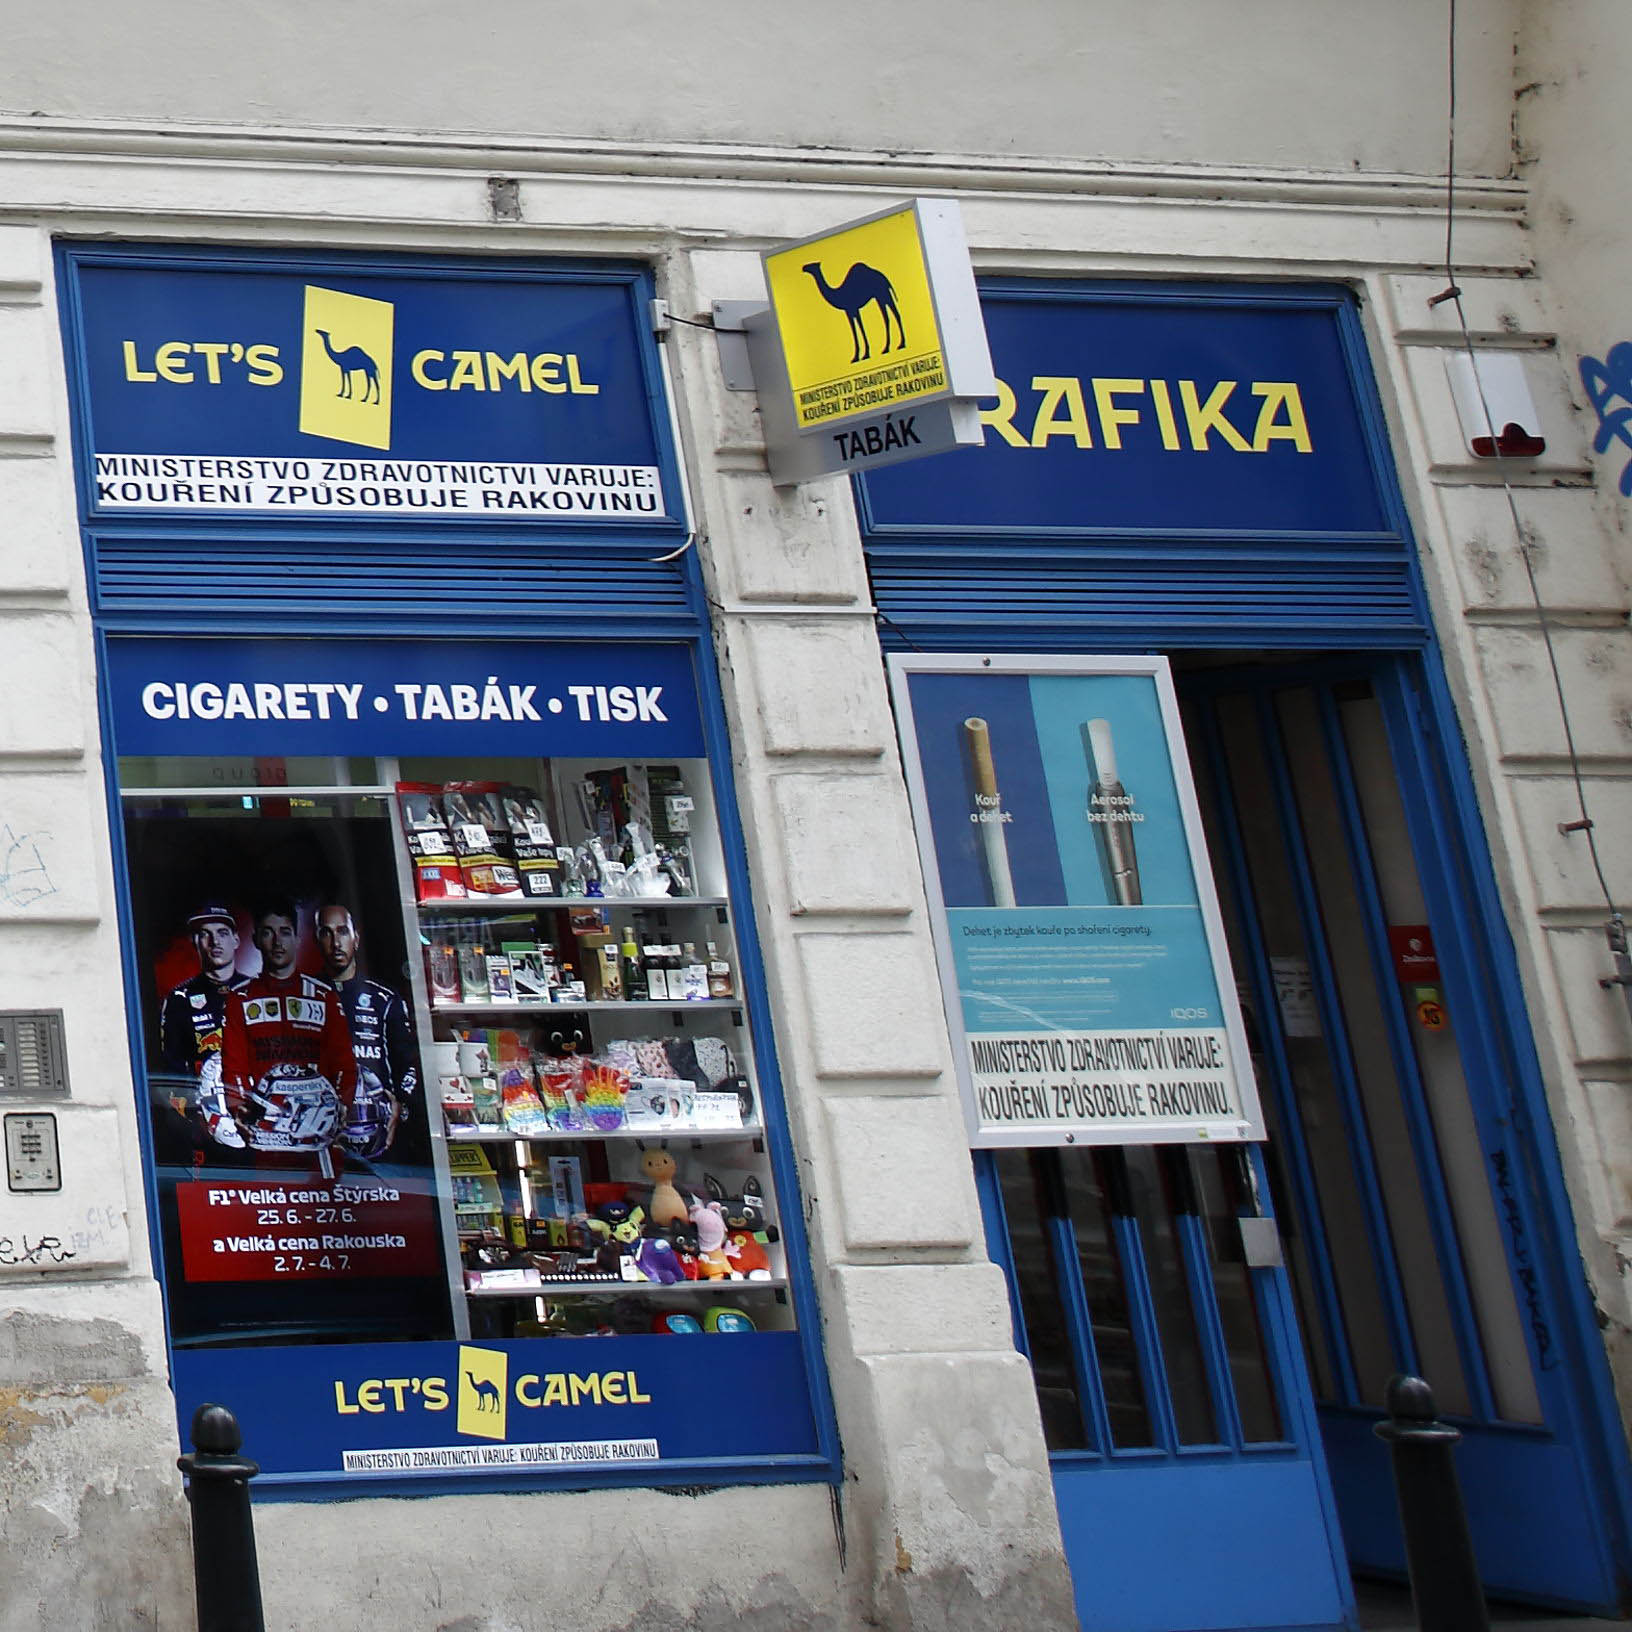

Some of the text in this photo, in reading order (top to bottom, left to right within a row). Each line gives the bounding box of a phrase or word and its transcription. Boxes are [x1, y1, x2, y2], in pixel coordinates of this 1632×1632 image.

[123, 340, 599, 394] LET'S CAMEL
[799, 378, 852, 406] MINISTERSTVO
[803, 372, 944, 422] KOUŘENÍ ZPŮSOBUJE RAKOVINU
[978, 377, 1313, 453] RAFIKA
[834, 414, 922, 462] TABÁK
[96, 456, 654, 488] MINISTERSTVO VARUJE:
[99, 479, 658, 511] KOUŘENÍ ZPŮSOBUJE RAKOVINU
[142, 676, 669, 722] CIGARETY TABÁK TISK
[975, 793, 1001, 806] Kouř
[1091, 793, 1135, 806] Aerosol
[1087, 810, 1105, 822] bez
[963, 925, 992, 936] Dehet
[992, 926, 1002, 939] je
[1004, 925, 1035, 939] zbytek
[1036, 925, 1062, 936] kouře
[1063, 928, 1076, 938] po
[1078, 924, 1111, 936] shoření
[971, 1030, 1224, 1074] MINISTERSTVO ZDRAVOTNICTVÍ VARUJE:
[978, 1076, 1234, 1120] KOUŘENÍ ZPŮSOBUJE RAKOVINU.
[238, 1184, 400, 1205] Velká cena Štýrska
[213, 1233, 407, 1252] a Velká cena Rakouska
[335, 1371, 652, 1414] LET'S CAMEL
[346, 1452, 411, 1469] MINISTERSTVO
[412, 1447, 480, 1466] ZDRAVOTNICTVÍ
[520, 1444, 558, 1462] KOUŘENÍ
[561, 1442, 609, 1461] ZPŮSOBUJE
[612, 1441, 657, 1459] RAKOVINU
